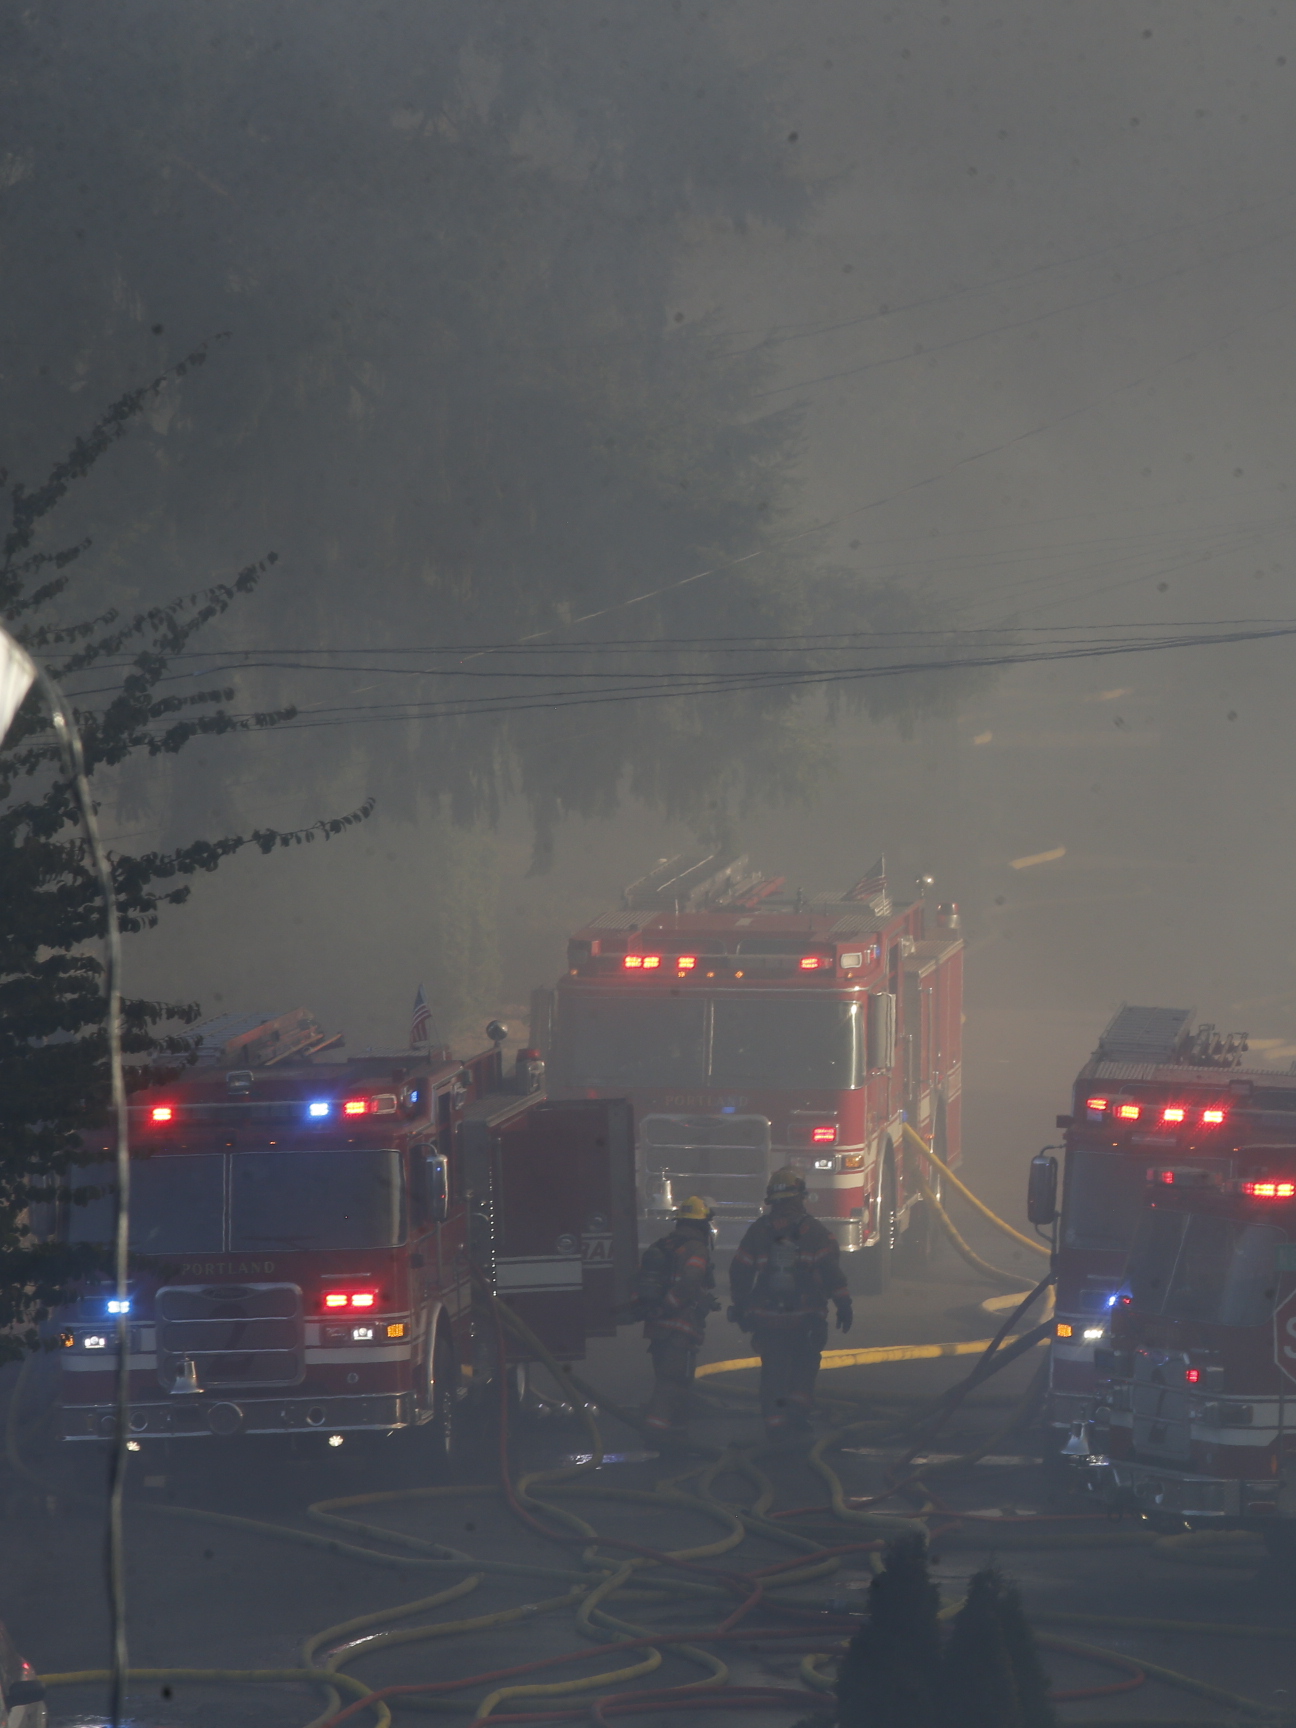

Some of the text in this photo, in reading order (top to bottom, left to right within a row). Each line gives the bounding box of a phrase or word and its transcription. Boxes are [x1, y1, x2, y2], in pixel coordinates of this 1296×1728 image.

[664, 1095, 748, 1107] PORTLAND
[181, 1261, 275, 1276] PORTLAND
[205, 1303, 255, 1376] 2
